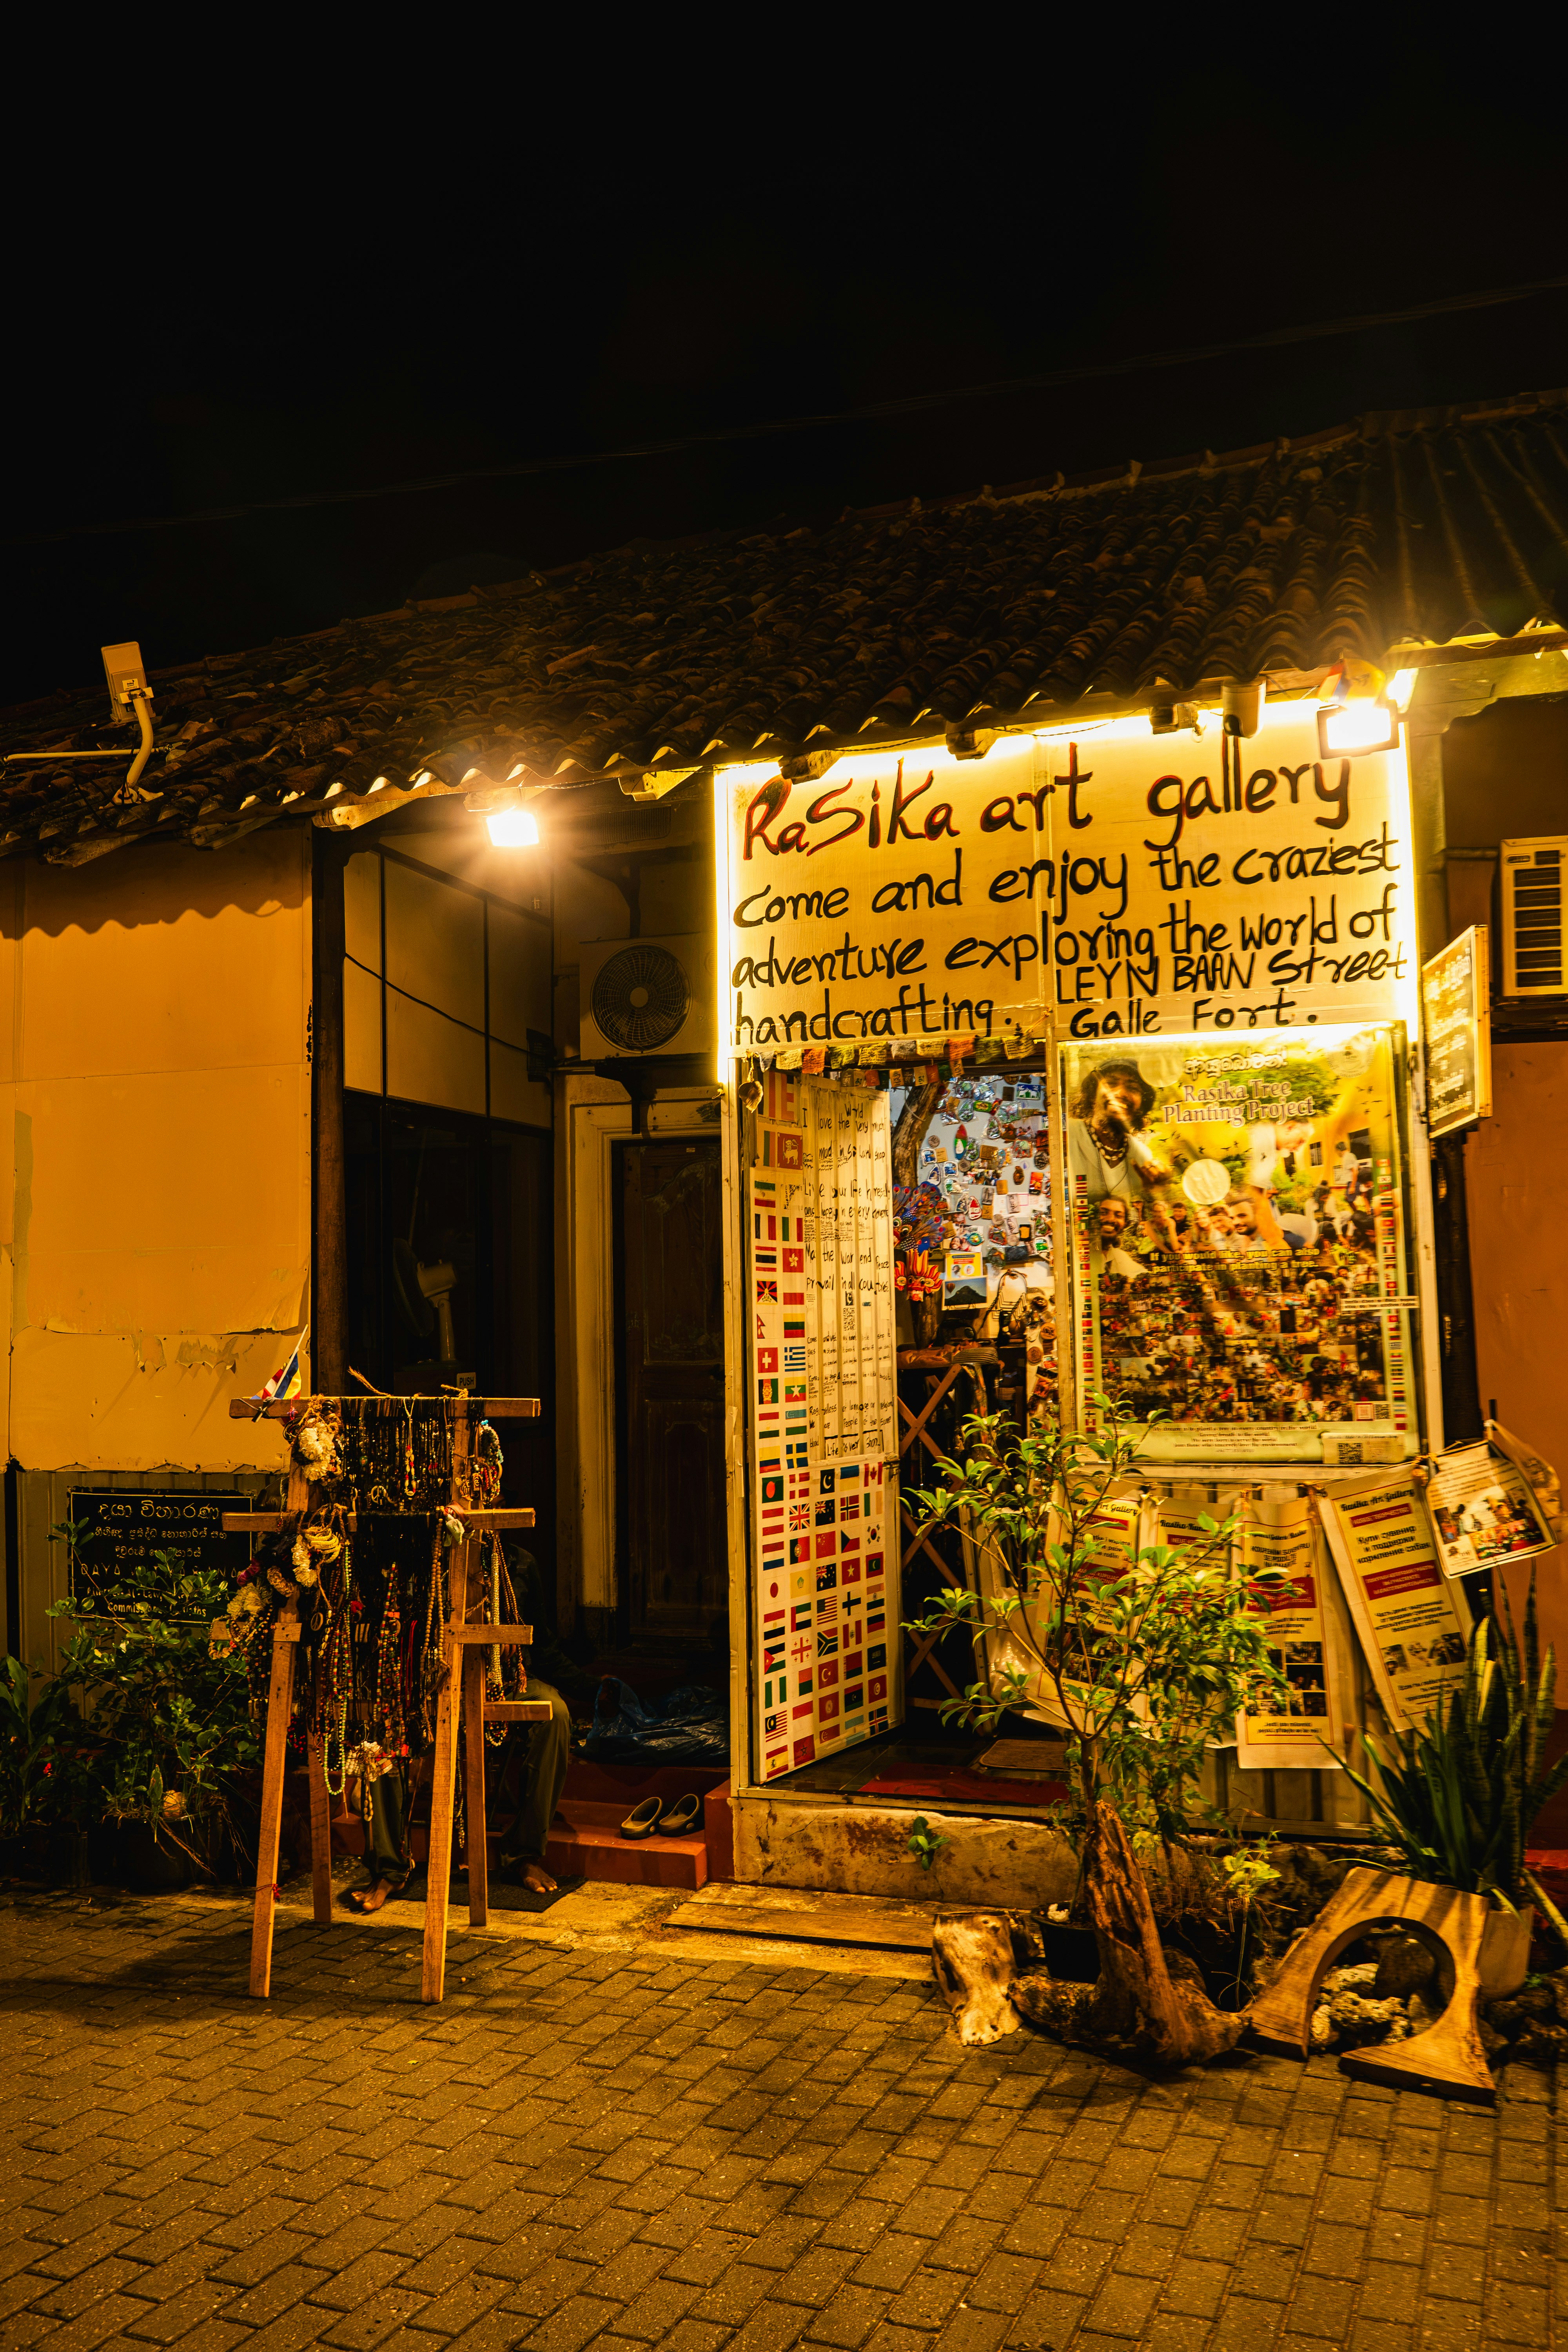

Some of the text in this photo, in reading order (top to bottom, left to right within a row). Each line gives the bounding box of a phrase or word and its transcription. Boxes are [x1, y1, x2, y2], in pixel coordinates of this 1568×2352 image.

[980, 742, 1093, 833] art
[1144, 729, 1350, 852] gallery
[872, 848, 963, 913] and
[989, 849, 1128, 924] enjoy
[1150, 845, 1221, 891] the
[1233, 822, 1399, 885] craziest
[732, 883, 1397, 988] adventure exploring the world of
[1056, 942, 1407, 1004] LEYN BAAN Street
[1070, 998, 1162, 1038] Galle
[1183, 1078, 1292, 1102] Rasika Tree
[802, 1108, 808, 1127] I
[818, 1108, 832, 1130] love
[838, 1112, 850, 1130] the
[844, 1102, 863, 1118] Wrld
[1162, 1096, 1316, 1127] Planting Project
[849, 1206, 870, 1220] eery
[822, 1241, 834, 1261] the
[860, 1247, 872, 1264] end
[1161, 1254, 1180, 1262] you
[1183, 1250, 1216, 1260] would
[1246, 1250, 1269, 1260] you
[1229, 1261, 1278, 1272] planting
[807, 1274, 834, 1291] prvail
[459, 1377, 474, 1386] PUSH
[809, 1403, 837, 1416] Regrdless
[1111, 1504, 1138, 1516] Gallery
